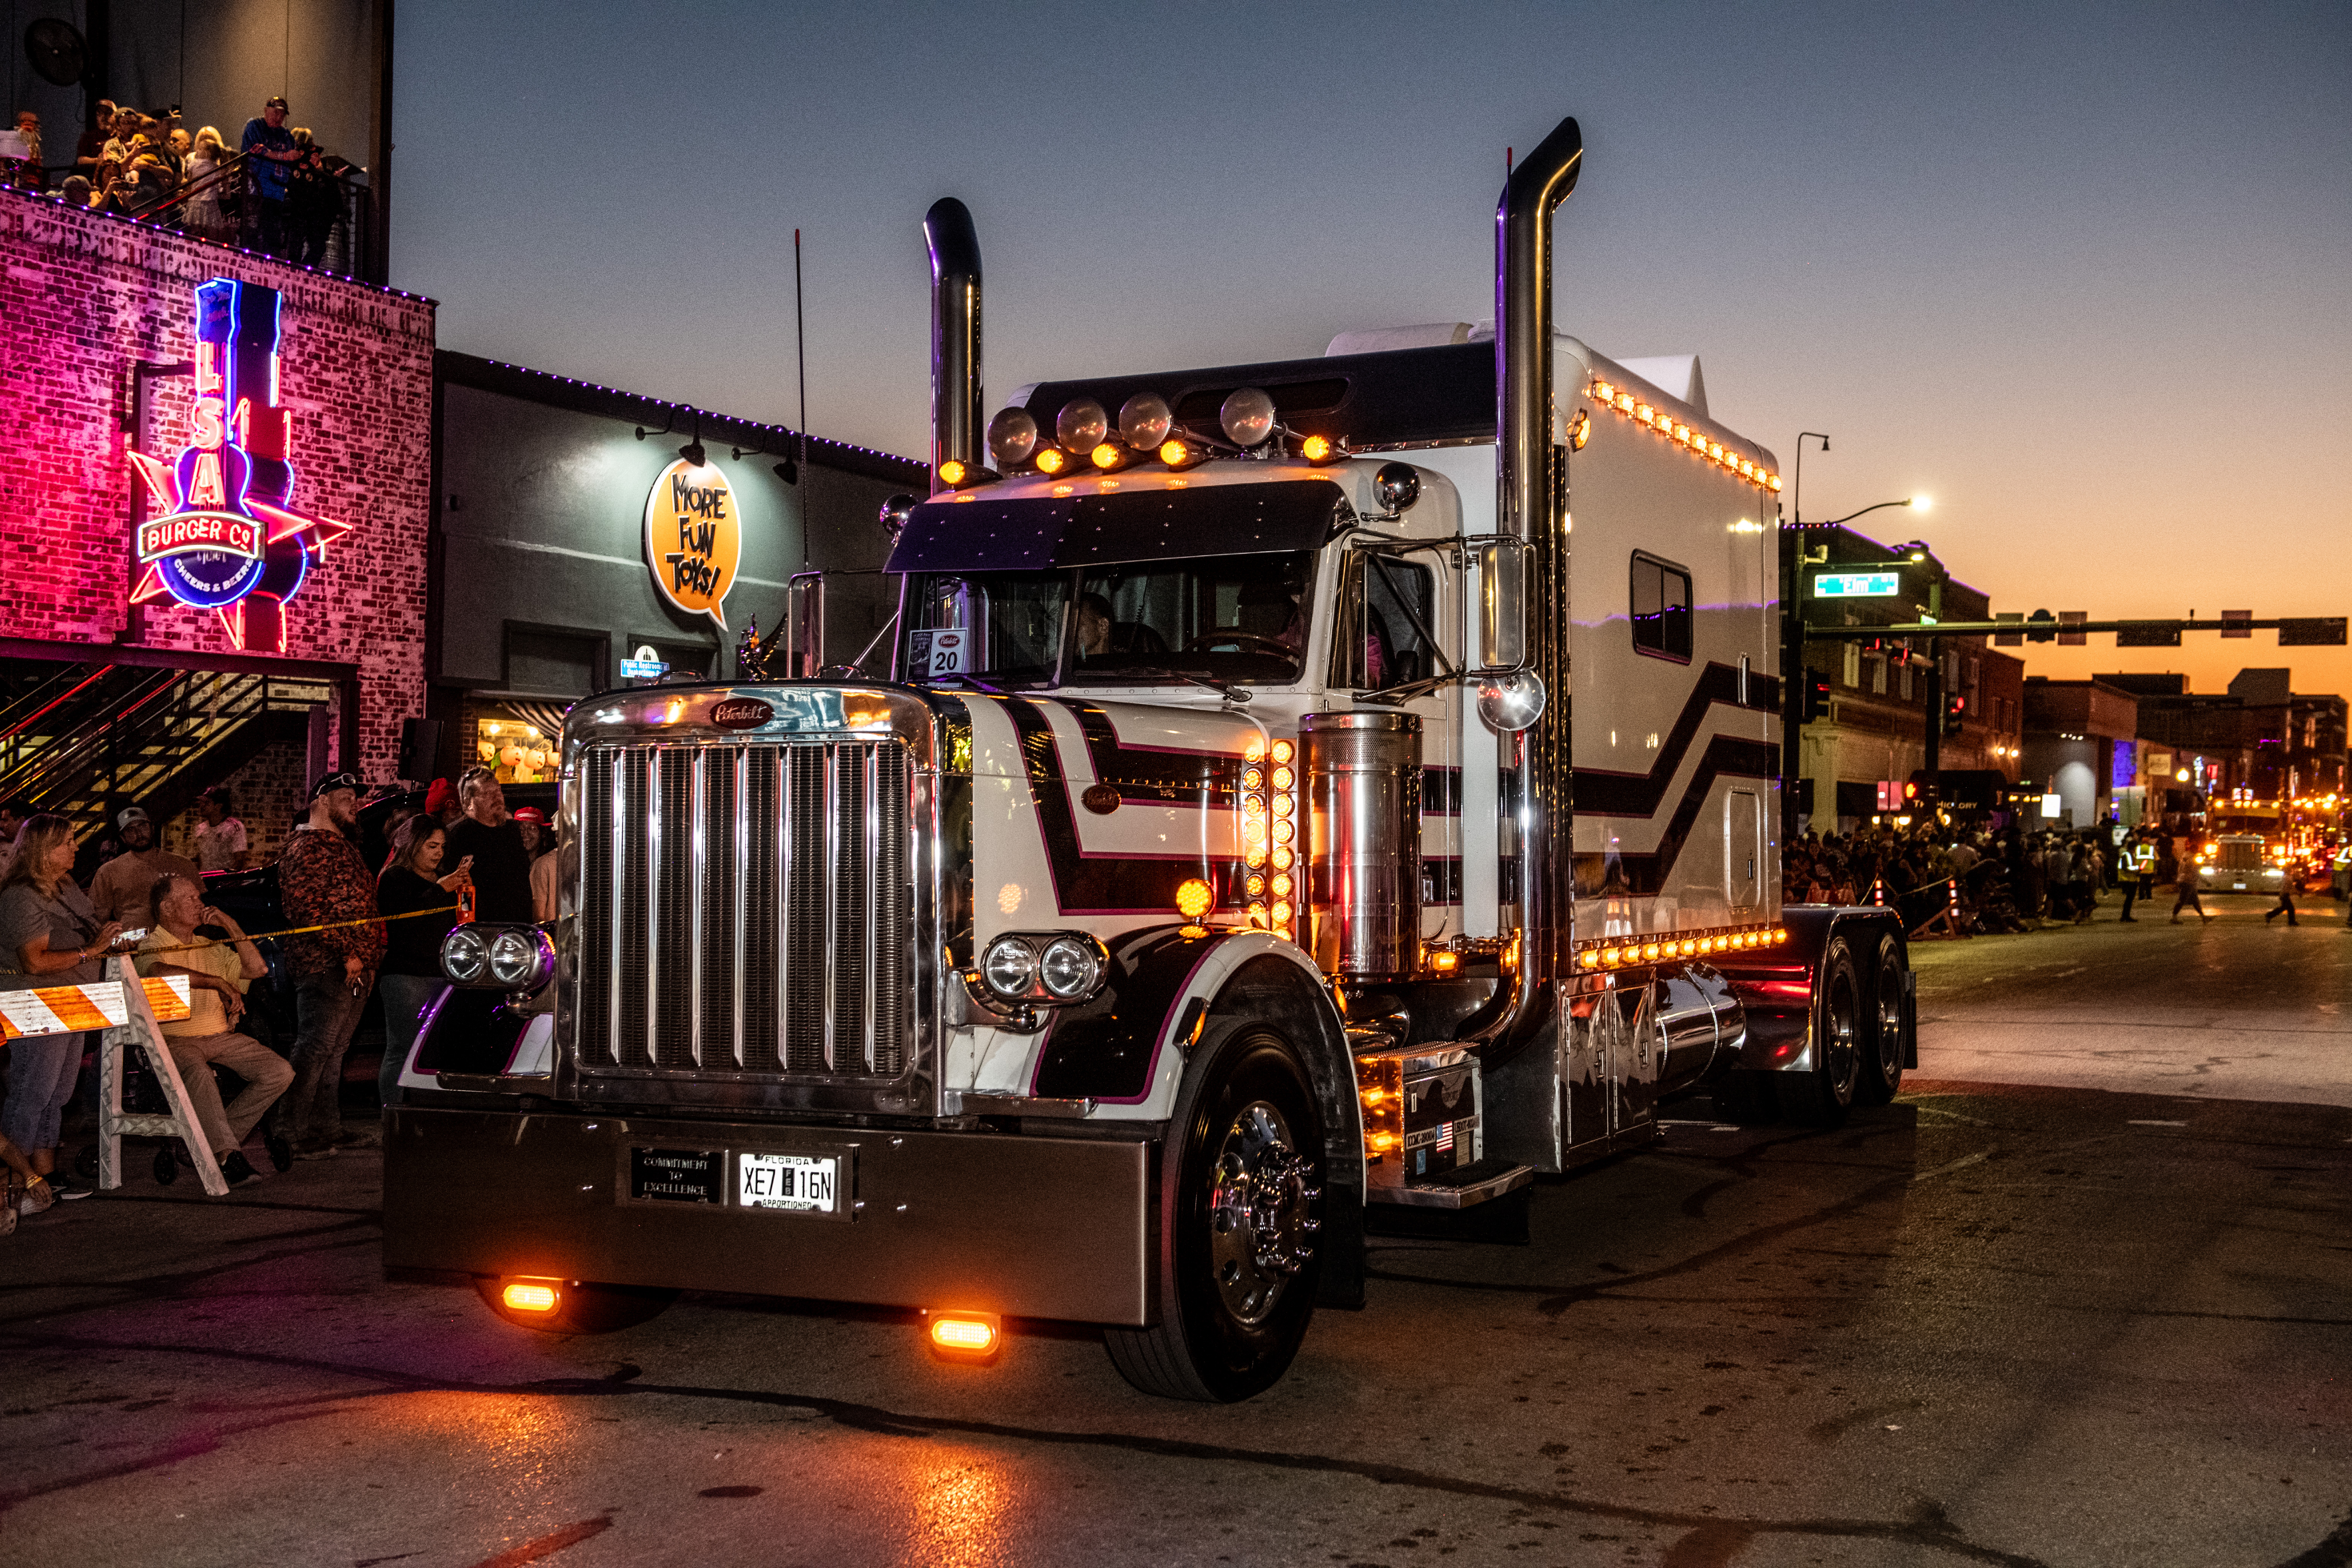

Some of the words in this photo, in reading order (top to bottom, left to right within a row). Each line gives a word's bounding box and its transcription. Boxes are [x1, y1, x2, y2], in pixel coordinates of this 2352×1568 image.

[188, 341, 226, 505] LSA
[671, 472, 727, 519] MORE
[148, 517, 222, 550] BURGER
[678, 515, 716, 560] FUN
[174, 558, 210, 592] CHEERS
[212, 583, 221, 592] &
[222, 558, 254, 590] BEERS
[665, 552, 721, 599] TOYS!
[1843, 577, 1868, 593] Elm
[639, 662, 662, 670] Restrooms
[935, 651, 957, 670] 20
[716, 705, 767, 722] Peterbilt
[1937, 800, 1977, 809] HICORY
[644, 1157, 709, 1170] COMMITMENT
[765, 1156, 809, 1165] FLORIDA
[669, 1171, 682, 1180] TO
[744, 1167, 775, 1195] XE7
[800, 1171, 831, 1200] 16N
[644, 1181, 708, 1195] EXCELLENCE
[762, 1199, 812, 1209] APPORTIONED
